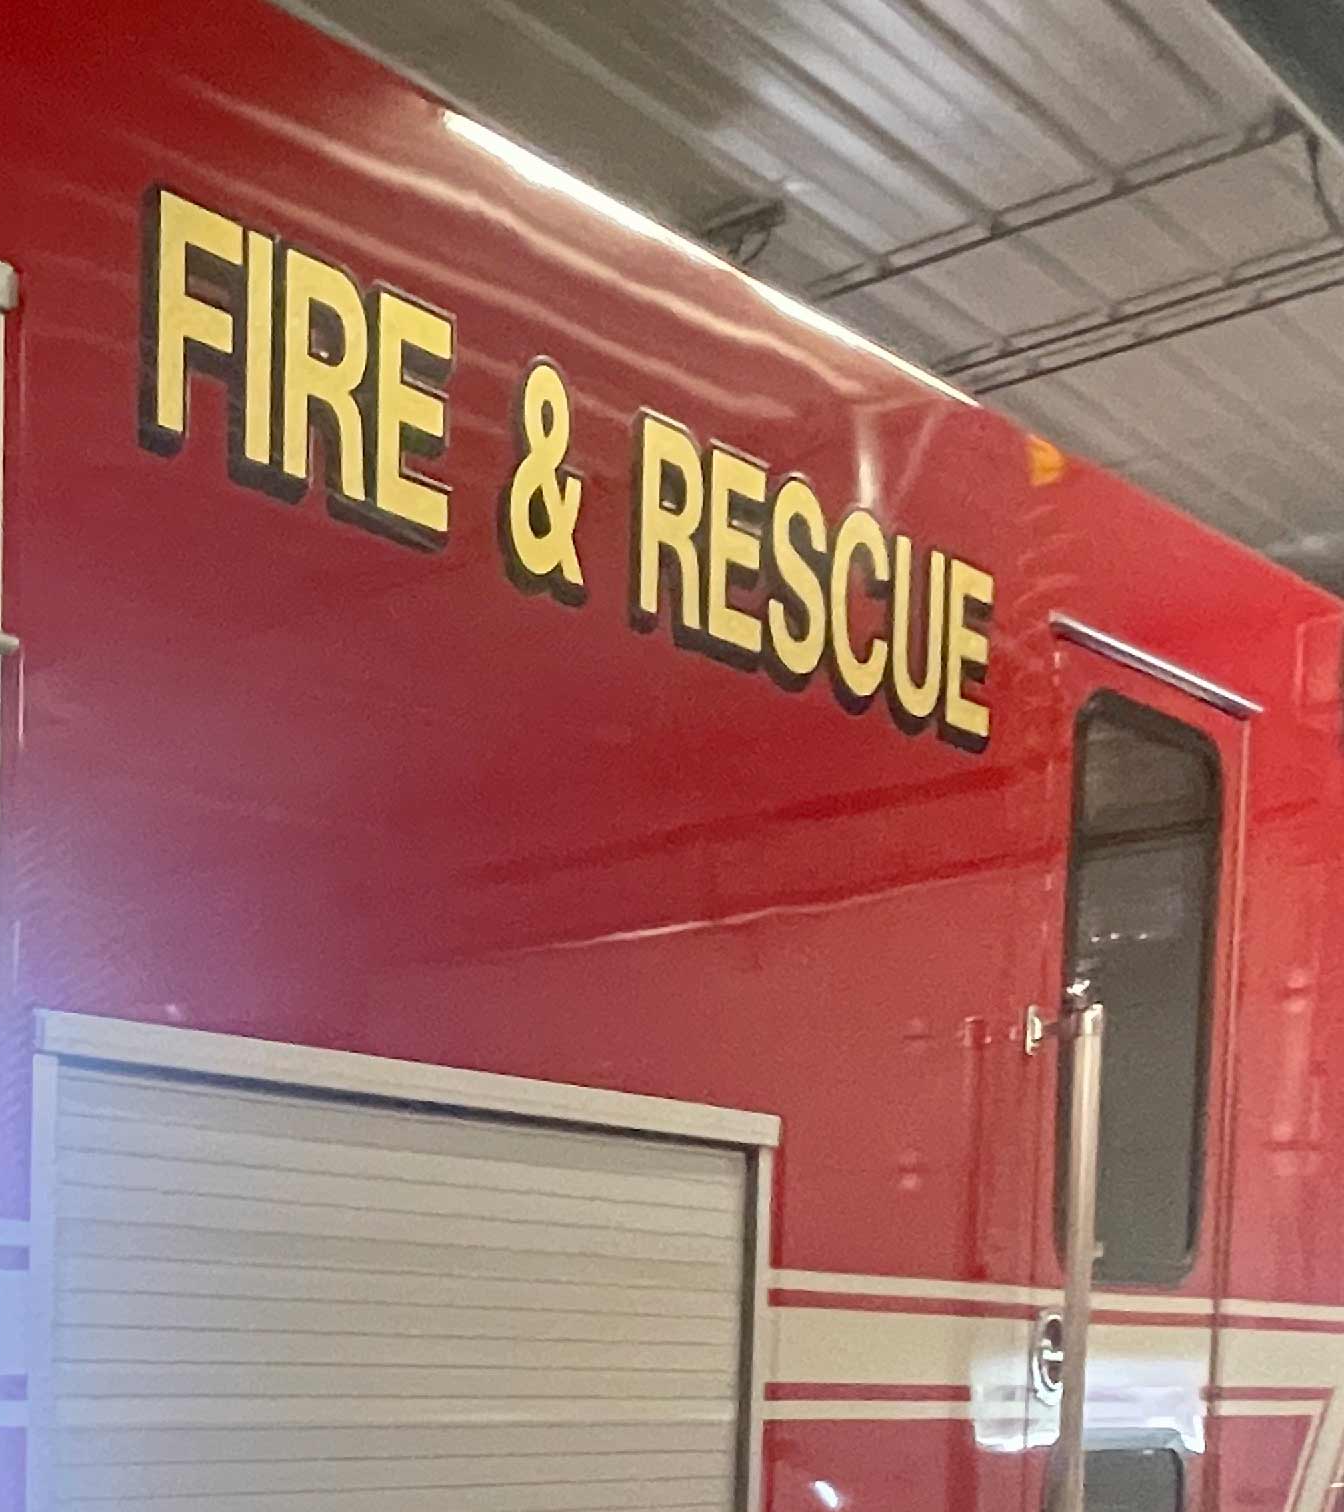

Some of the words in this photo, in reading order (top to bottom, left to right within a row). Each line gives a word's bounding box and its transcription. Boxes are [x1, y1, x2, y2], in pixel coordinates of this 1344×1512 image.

[140, 183, 454, 551] FIRE
[500, 356, 586, 604] &
[629, 406, 995, 752] RESCUE
